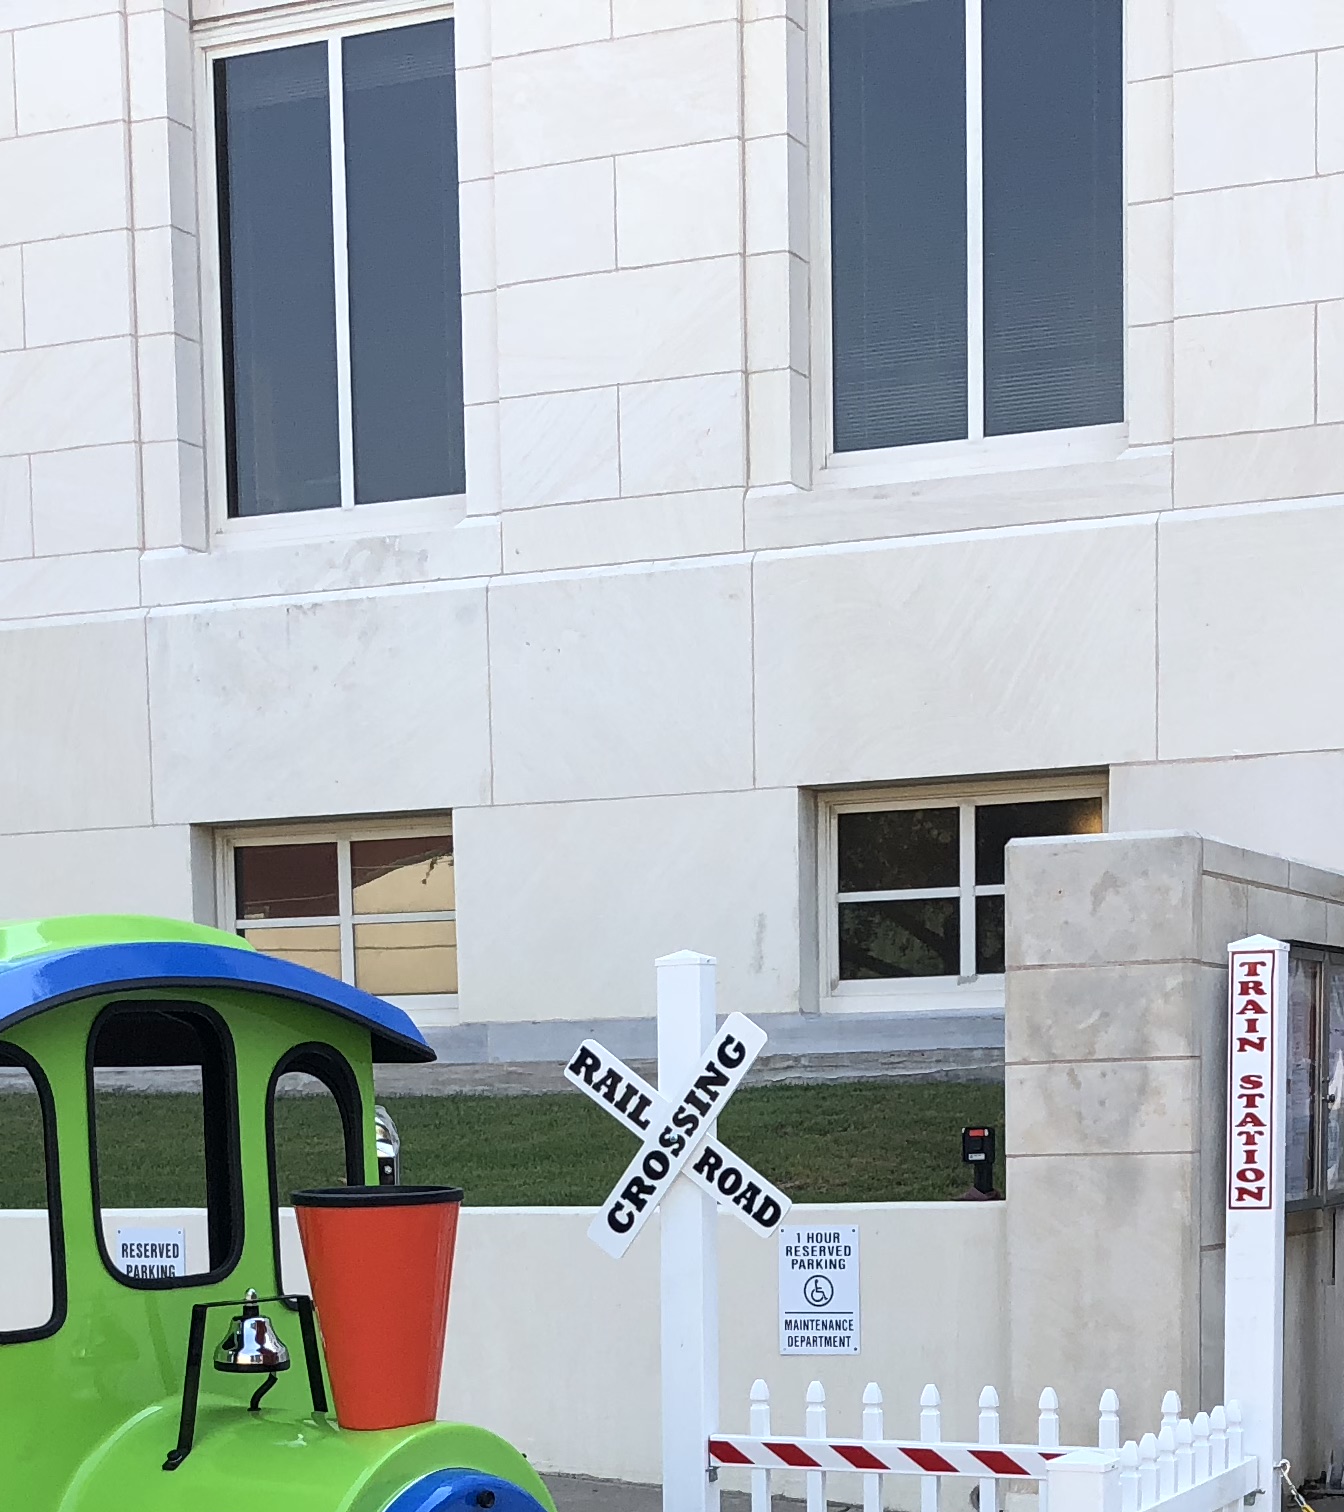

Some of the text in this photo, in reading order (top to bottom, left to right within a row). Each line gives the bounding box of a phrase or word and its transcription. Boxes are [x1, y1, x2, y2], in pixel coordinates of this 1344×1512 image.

[1235, 961, 1268, 1202] TRAIN STATION
[568, 1045, 782, 1228] RAIL ROAD
[607, 1033, 746, 1234] CROSSING
[796, 1232, 840, 1243] 1 HOUR
[121, 1243, 180, 1258] RESERVED
[785, 1245, 852, 1257] RESERVED
[791, 1258, 846, 1270] PARKING
[126, 1264, 176, 1279] PARKING
[784, 1319, 854, 1331] MAINTENANCE
[787, 1336, 851, 1348] DEPARTMENT
